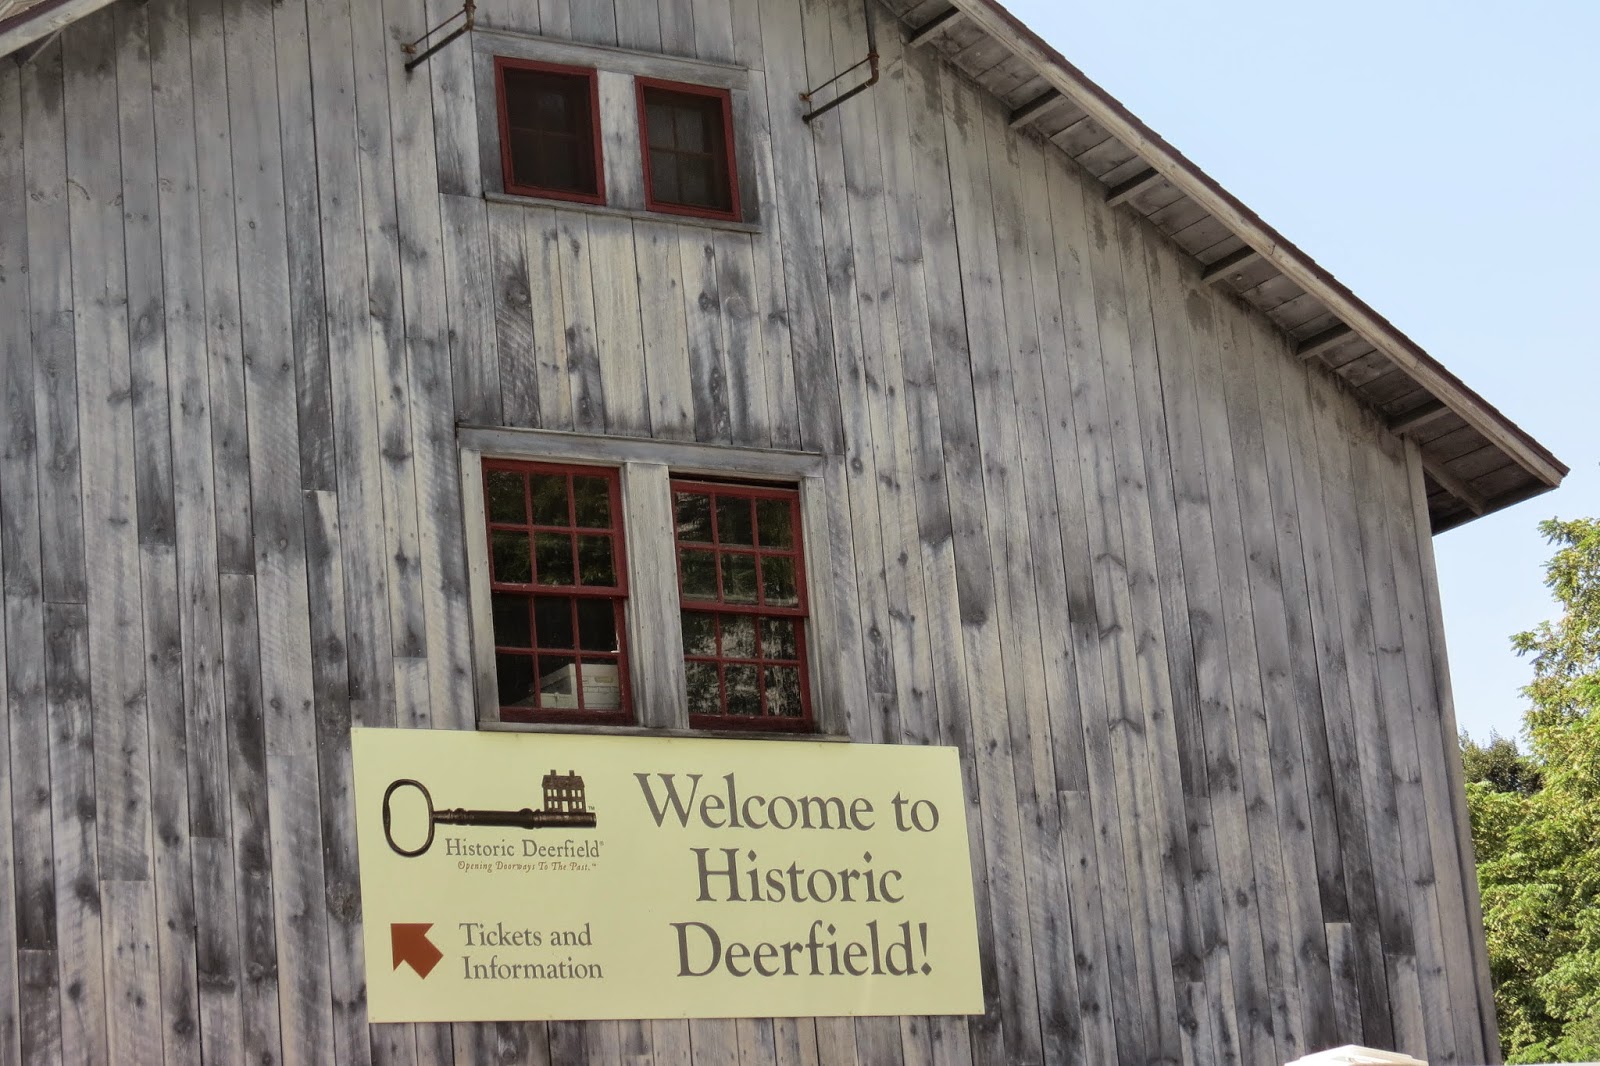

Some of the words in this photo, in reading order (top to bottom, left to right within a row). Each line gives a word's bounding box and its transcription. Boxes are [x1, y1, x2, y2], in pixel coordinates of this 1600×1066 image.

[633, 772, 875, 830] Welcome
[891, 791, 939, 832] to
[445, 838, 515, 857] Historic
[458, 861, 492, 873] Opening
[495, 861, 535, 873] Doorways
[538, 862, 548, 871] To
[552, 862, 567, 871] The
[690, 847, 904, 903] Historic
[458, 922, 542, 947] Tickets
[550, 923, 592, 947] and
[669, 919, 932, 977] Deerfield!
[461, 956, 604, 980] Information
